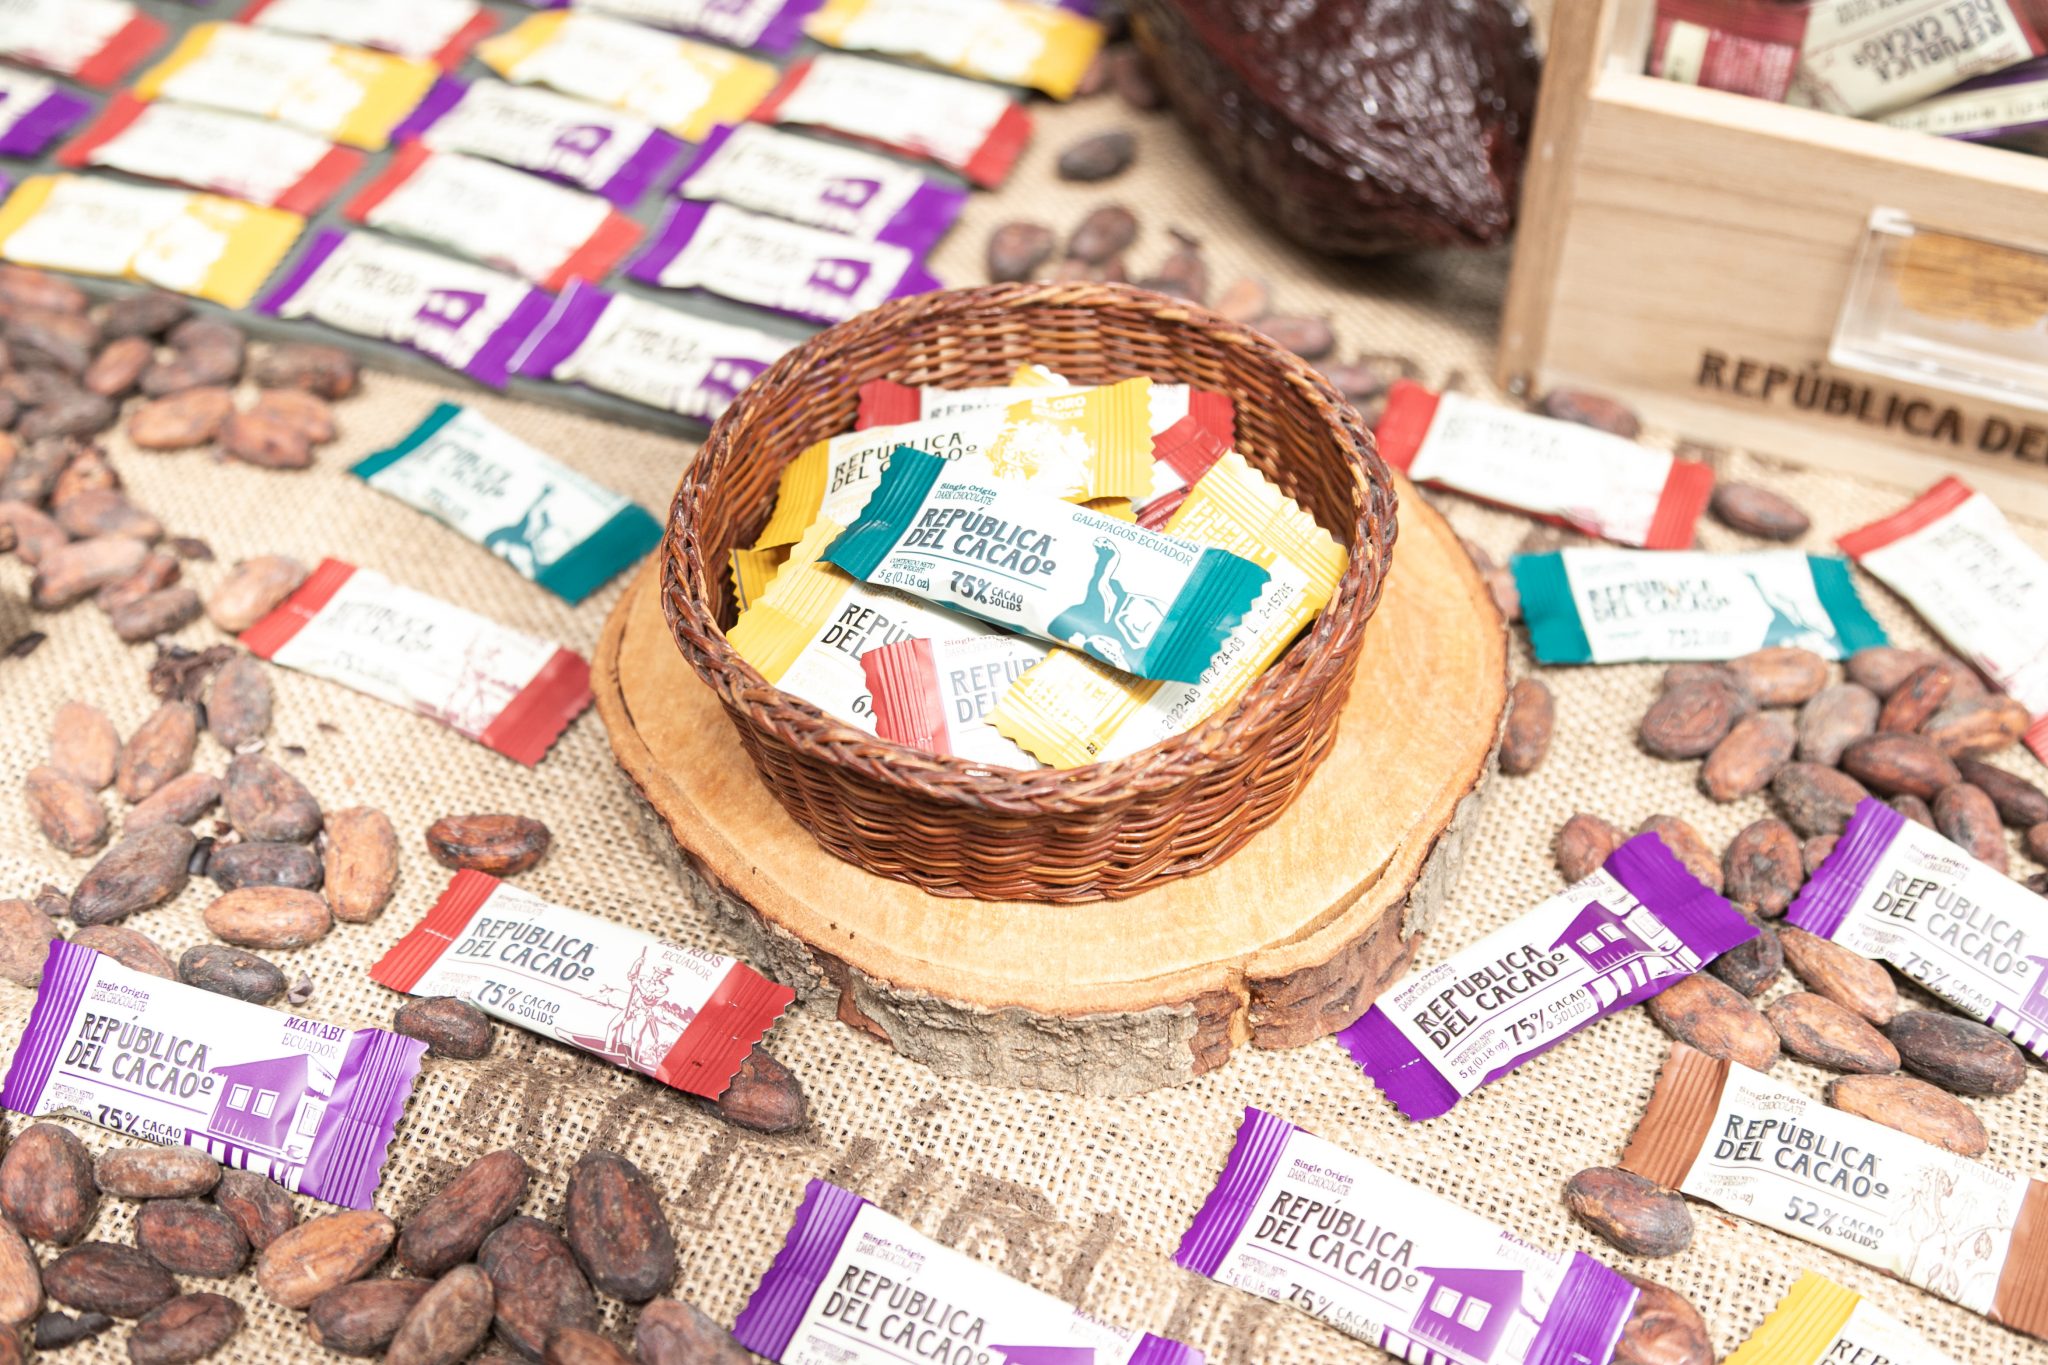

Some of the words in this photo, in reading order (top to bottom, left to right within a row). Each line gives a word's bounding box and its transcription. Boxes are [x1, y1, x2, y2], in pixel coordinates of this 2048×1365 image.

[1697, 351, 1965, 445] REPÚBLICA
[1978, 415, 2048, 467] DE
[834, 432, 964, 479] REPÚICA
[831, 464, 869, 494] DEL
[940, 483, 966, 493] Single
[969, 485, 997, 497] Origin
[903, 528, 946, 549] DEL
[918, 507, 1053, 557] REPÚBLICA
[1137, 535, 1193, 567] ECUADOR
[878, 569, 887, 579] 5
[884, 572, 893, 584] g
[893, 571, 916, 586] (0.18
[916, 577, 930, 591] oz)
[950, 570, 991, 605] 75%
[992, 586, 1024, 604] CACAO
[988, 596, 1022, 613] SOLIDS
[1873, 891, 1917, 923] DEL
[1886, 869, 2026, 955] REPÚBLICA
[455, 938, 497, 958] DEL
[472, 917, 594, 964] REPÚBLICA
[662, 951, 713, 981] ECUADOR
[1901, 951, 1950, 993] 75%
[96, 979, 119, 992] Single
[121, 981, 150, 1000] Origin
[477, 980, 522, 1012] 75%
[1413, 943, 1544, 1034] REPÚBLICA
[1548, 989, 1586, 1014] CACAO
[1952, 979, 1992, 1008] CACAO
[517, 1005, 554, 1026] SOLIDS
[523, 994, 560, 1014] CACAO
[1554, 999, 1592, 1025] SOLIDS
[78, 1011, 208, 1071] REPÚBLICA
[1429, 1013, 1478, 1050] DEL
[1504, 1009, 1553, 1045] 75%
[65, 1040, 103, 1072] DEL
[281, 1033, 338, 1060] ECUADOR
[1459, 1070, 1468, 1079] 5
[1468, 1065, 1477, 1075] g
[1476, 1047, 1495, 1069] (0.18
[43, 1099, 51, 1110] 5
[1773, 1093, 1807, 1106] Origin
[98, 1104, 140, 1136] 75%
[143, 1119, 182, 1139] CACAO
[1714, 1139, 1764, 1162] DEL
[1723, 1113, 1878, 1177] REPÚBLICA
[1287, 1168, 1306, 1182] DARK
[1308, 1174, 1351, 1196] CHOCOLATE
[1294, 1159, 1321, 1173] Single
[1324, 1168, 1354, 1184] Origin
[1269, 1190, 1413, 1267] REPÚBLICA
[1784, 1195, 1839, 1236] 52%
[1842, 1215, 1884, 1238] CACAO
[1255, 1214, 1299, 1250] DEL
[1835, 1226, 1879, 1250] SOLIDS
[855, 1241, 875, 1256] DARK
[1226, 1268, 1235, 1279] 5
[822, 1291, 871, 1332] DEL
[837, 1264, 985, 1345] REPÚBLICA
[1289, 1283, 1333, 1323] 75%
[1337, 1307, 1379, 1335] CACAO
